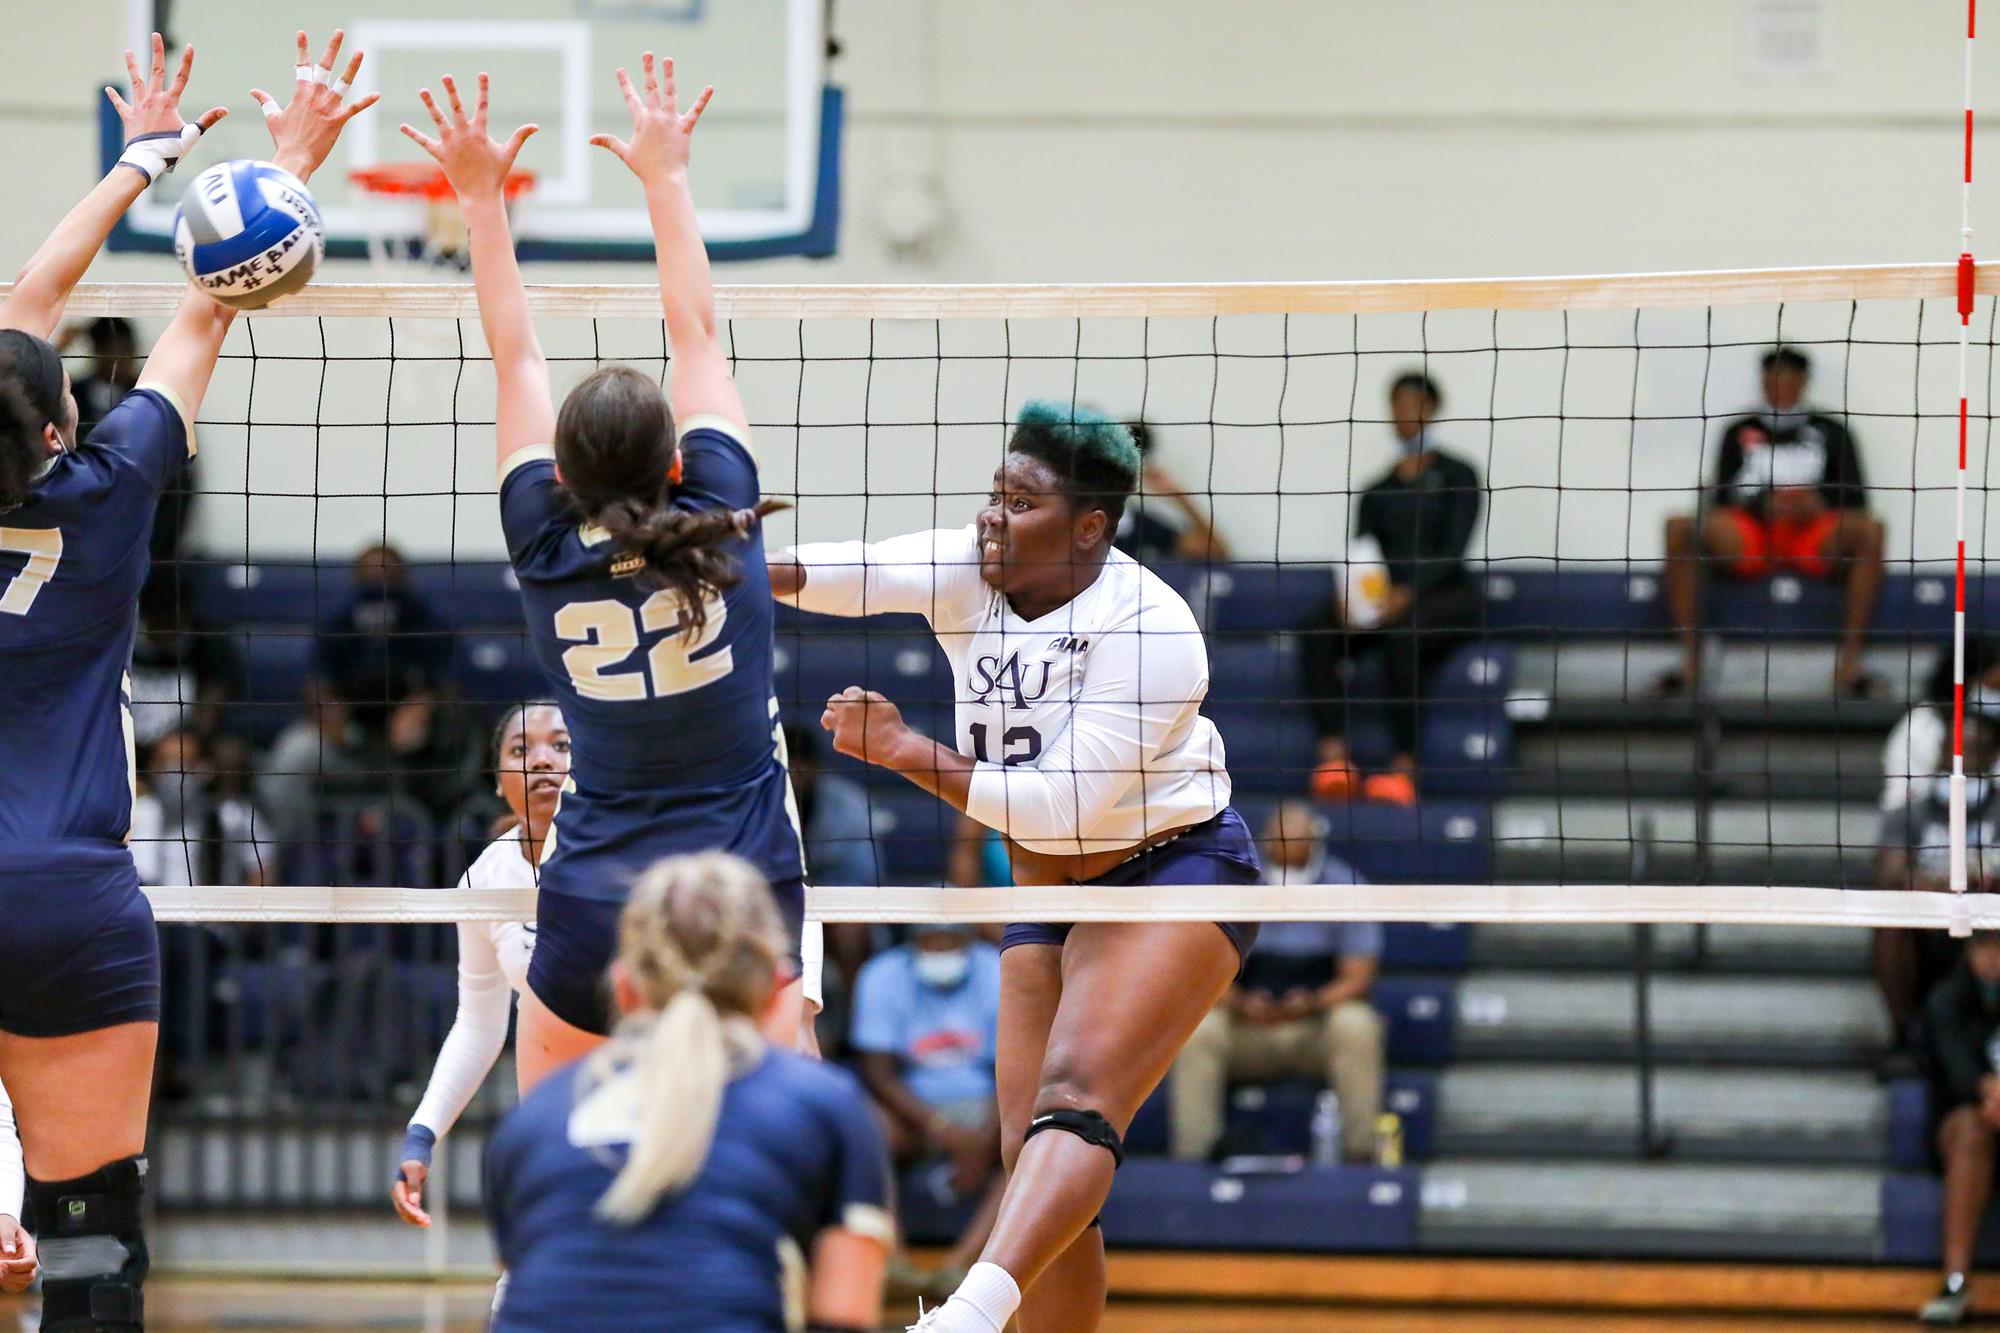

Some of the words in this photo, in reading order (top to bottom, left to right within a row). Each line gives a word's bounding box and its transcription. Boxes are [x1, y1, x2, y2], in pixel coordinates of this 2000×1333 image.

[0, 527, 64, 616] 7
[554, 579, 734, 700] 22
[968, 650, 1056, 710] SAU
